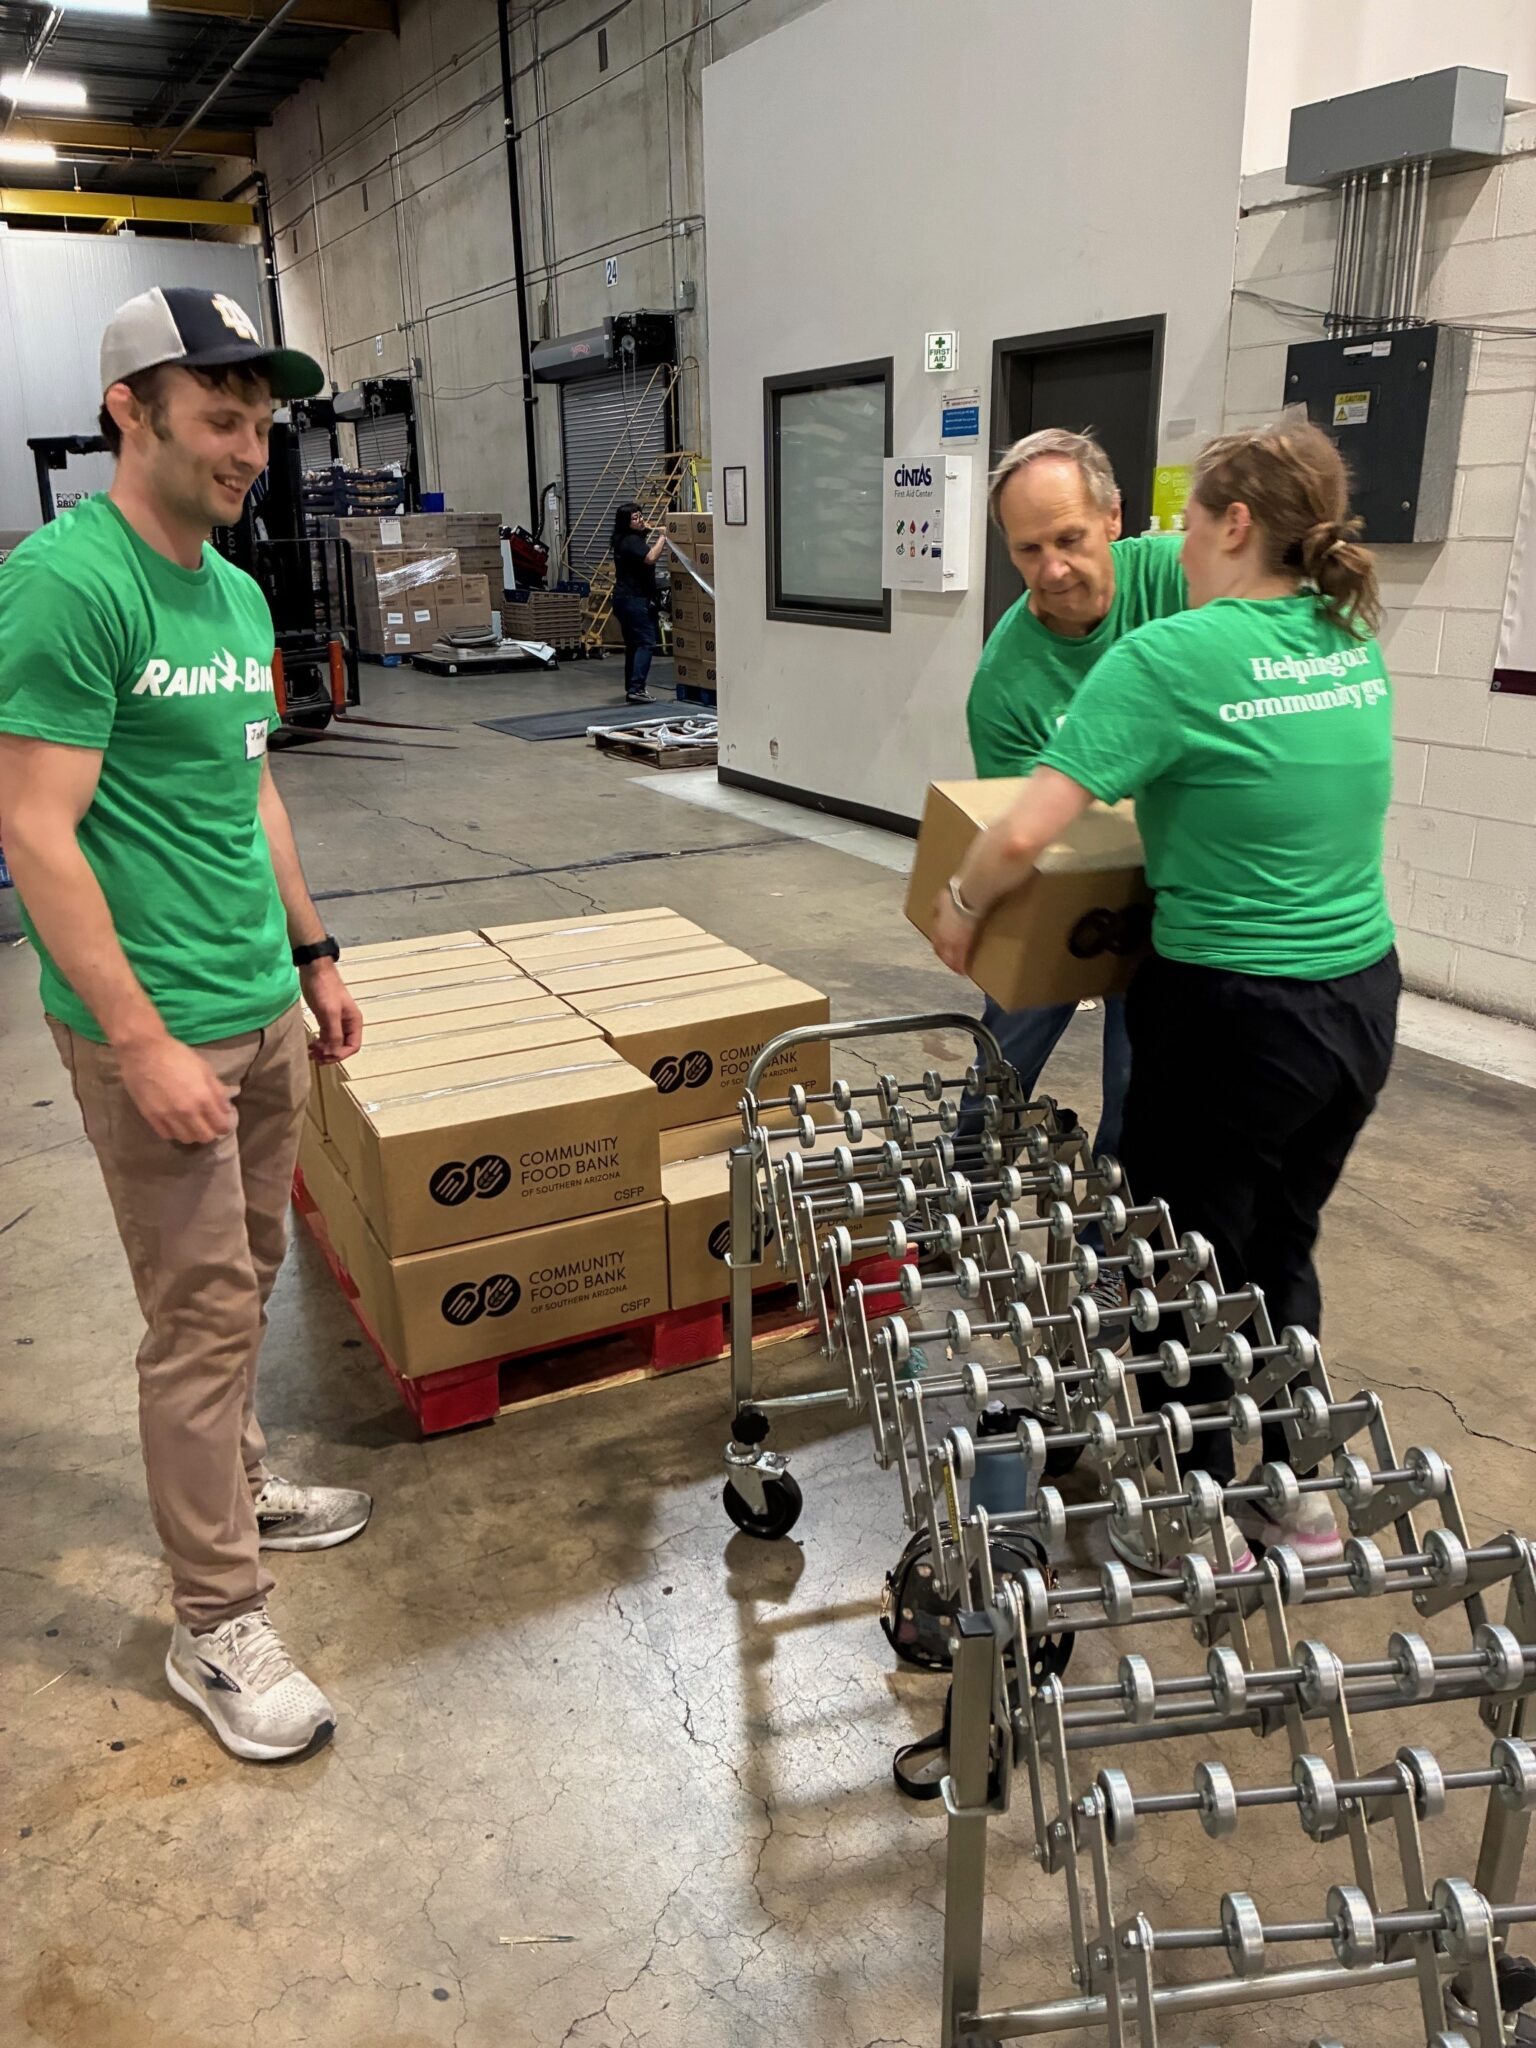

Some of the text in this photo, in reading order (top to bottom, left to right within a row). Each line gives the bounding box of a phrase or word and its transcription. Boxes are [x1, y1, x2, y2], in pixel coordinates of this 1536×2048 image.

[606, 260, 618, 285] 24
[929, 348, 950, 356] FIRST
[57, 500, 77, 508] DRIV
[227, 529, 237, 556] TOY
[131, 657, 274, 697] RAIN BIR
[1249, 647, 1371, 684] Helping our
[1219, 682, 1362, 722] community
[720, 1060, 753, 1077] FOO
[766, 1051, 798, 1068] ANK
[769, 1066, 798, 1078] ARIZONA
[720, 1080, 731, 1088] OF
[520, 1136, 619, 1167] COMMUNITY
[521, 1153, 619, 1185] FOOD BANK
[521, 1171, 621, 1198] OF SOUTHERN ARIZONA
[614, 1186, 645, 1201] CSFP
[529, 1250, 625, 1285] COMMUNITY
[530, 1266, 626, 1302] FOOD BANK
[530, 1284, 628, 1314] OF SOUTHERN ARIZONA
[620, 1297, 651, 1313] CSFP
